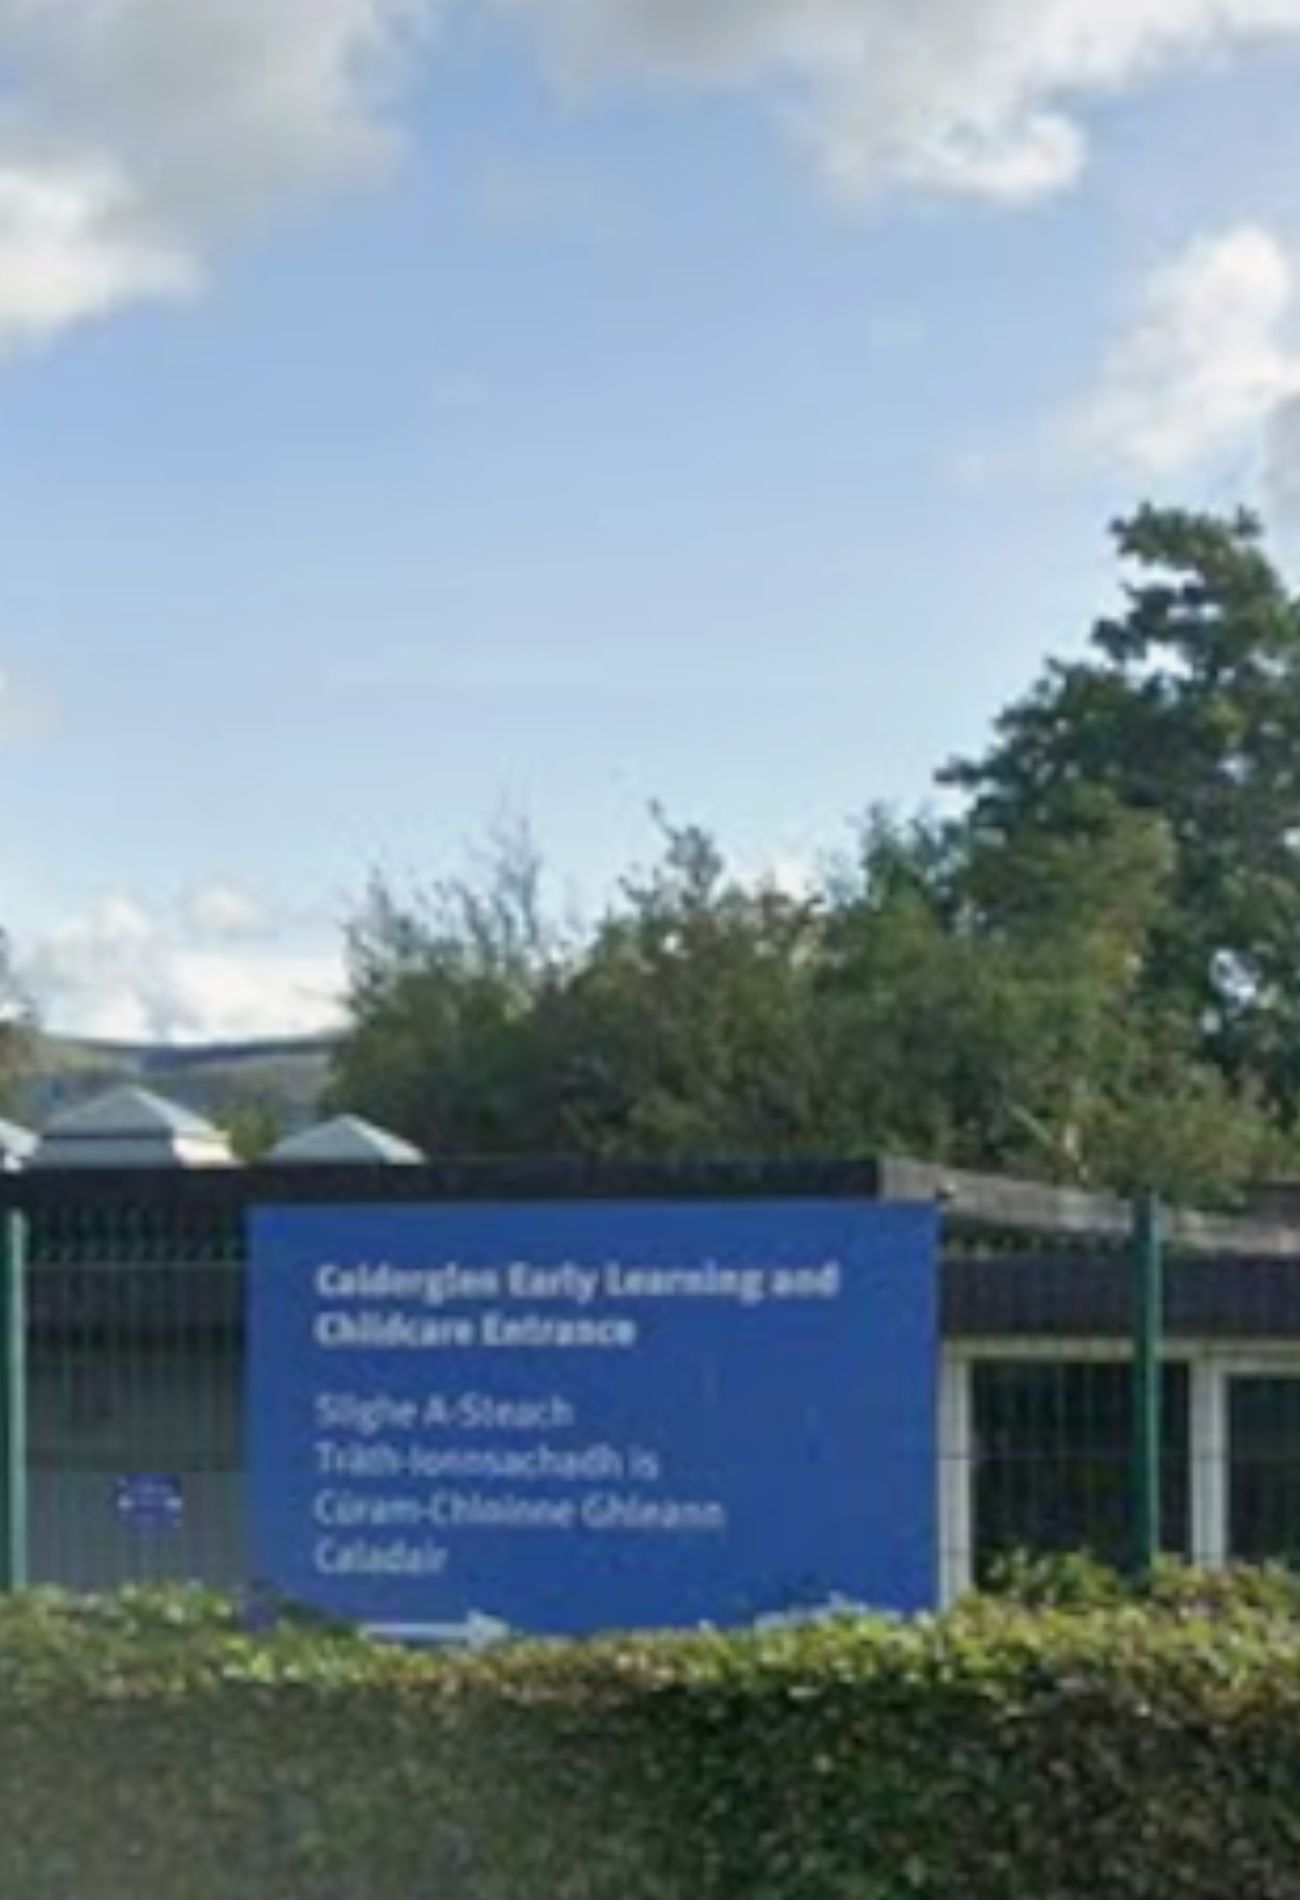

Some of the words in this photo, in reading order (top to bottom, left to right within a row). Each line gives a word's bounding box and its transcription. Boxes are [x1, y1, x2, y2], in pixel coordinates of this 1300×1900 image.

[316, 1263, 498, 1306] Calderglen
[508, 1261, 598, 1305] Early
[606, 1258, 762, 1306] Learning
[770, 1260, 840, 1298] and
[314, 1311, 474, 1347] Childcare
[481, 1312, 637, 1346] Entrance
[629, 1445, 659, 1480] is
